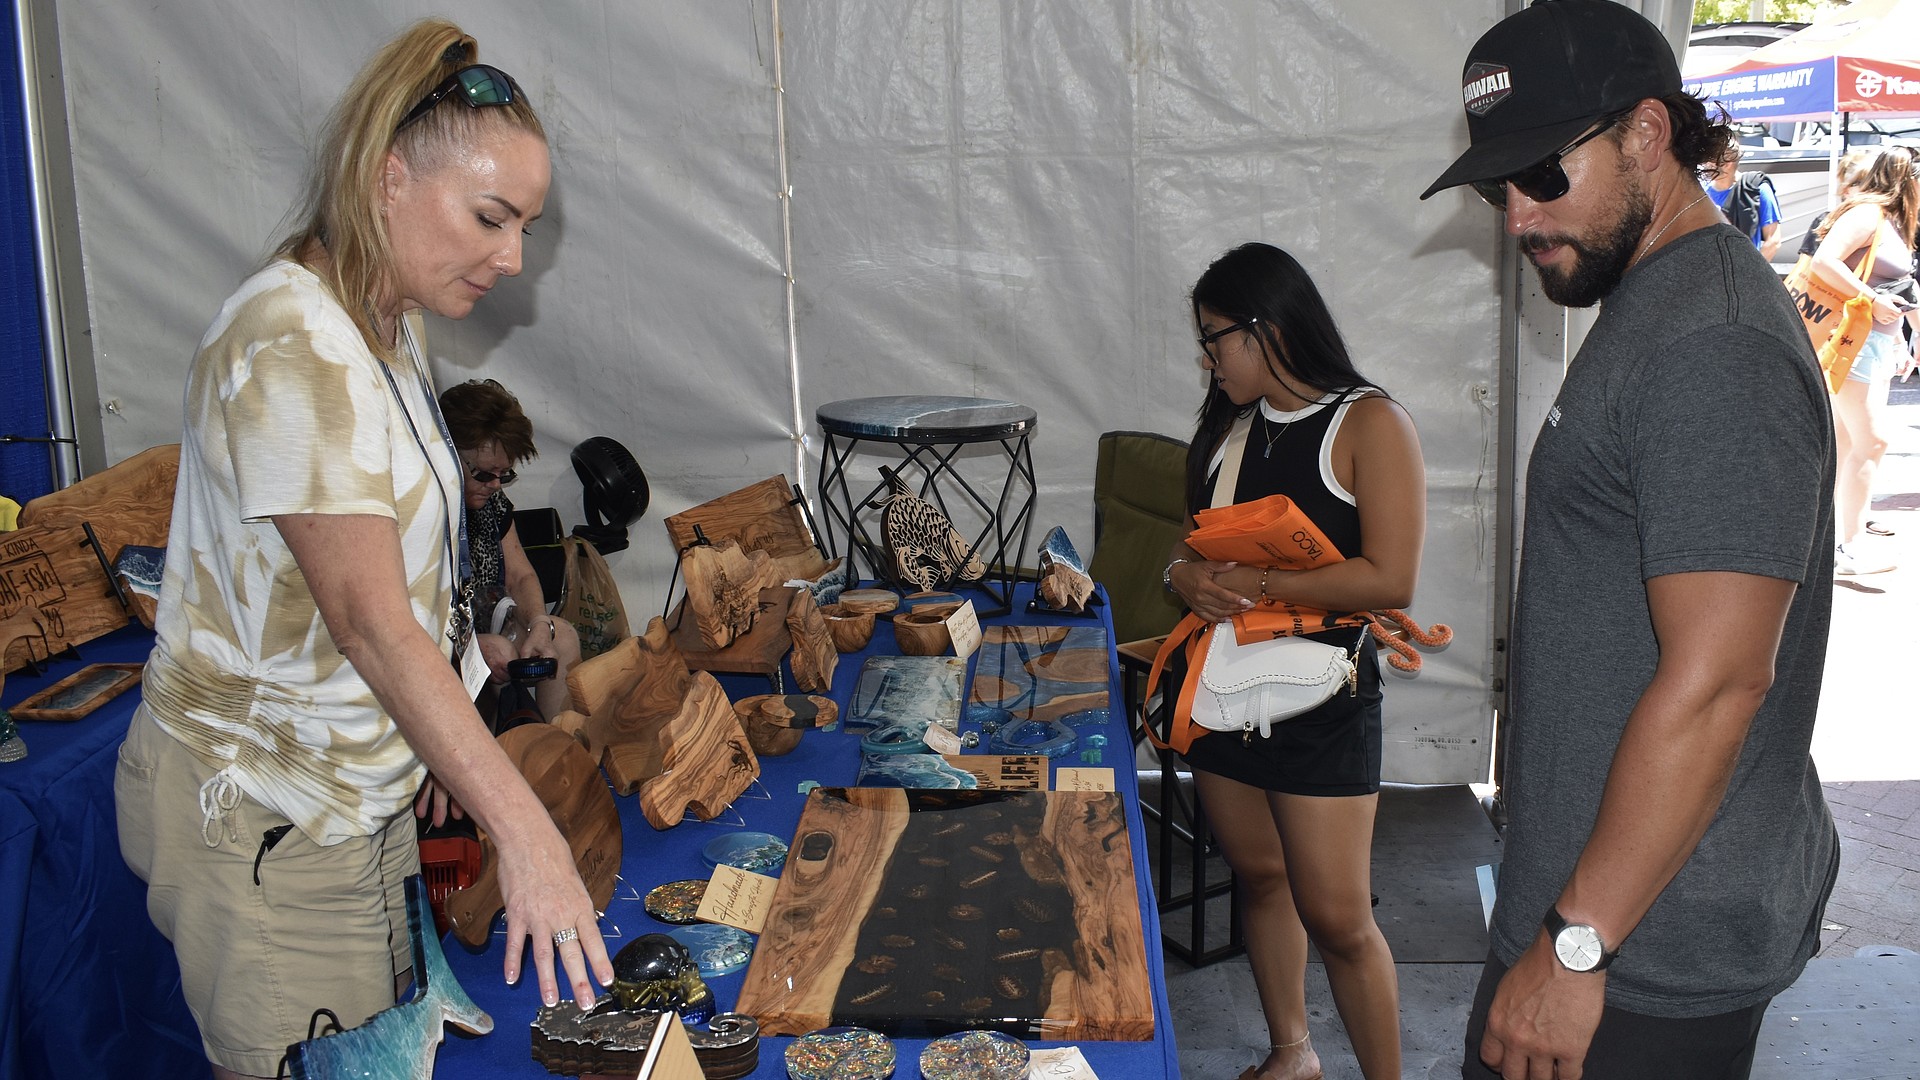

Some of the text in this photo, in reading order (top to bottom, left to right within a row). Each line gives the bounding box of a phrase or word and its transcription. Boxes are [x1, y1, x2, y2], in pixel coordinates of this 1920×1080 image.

[1463, 71, 1511, 104] HAWAII
[1757, 67, 1815, 92] WARRANTY
[4, 537, 39, 557] KINDA
[1292, 531, 1324, 560] TACO
[577, 622, 603, 637] and
[712, 867, 746, 921] Handmade
